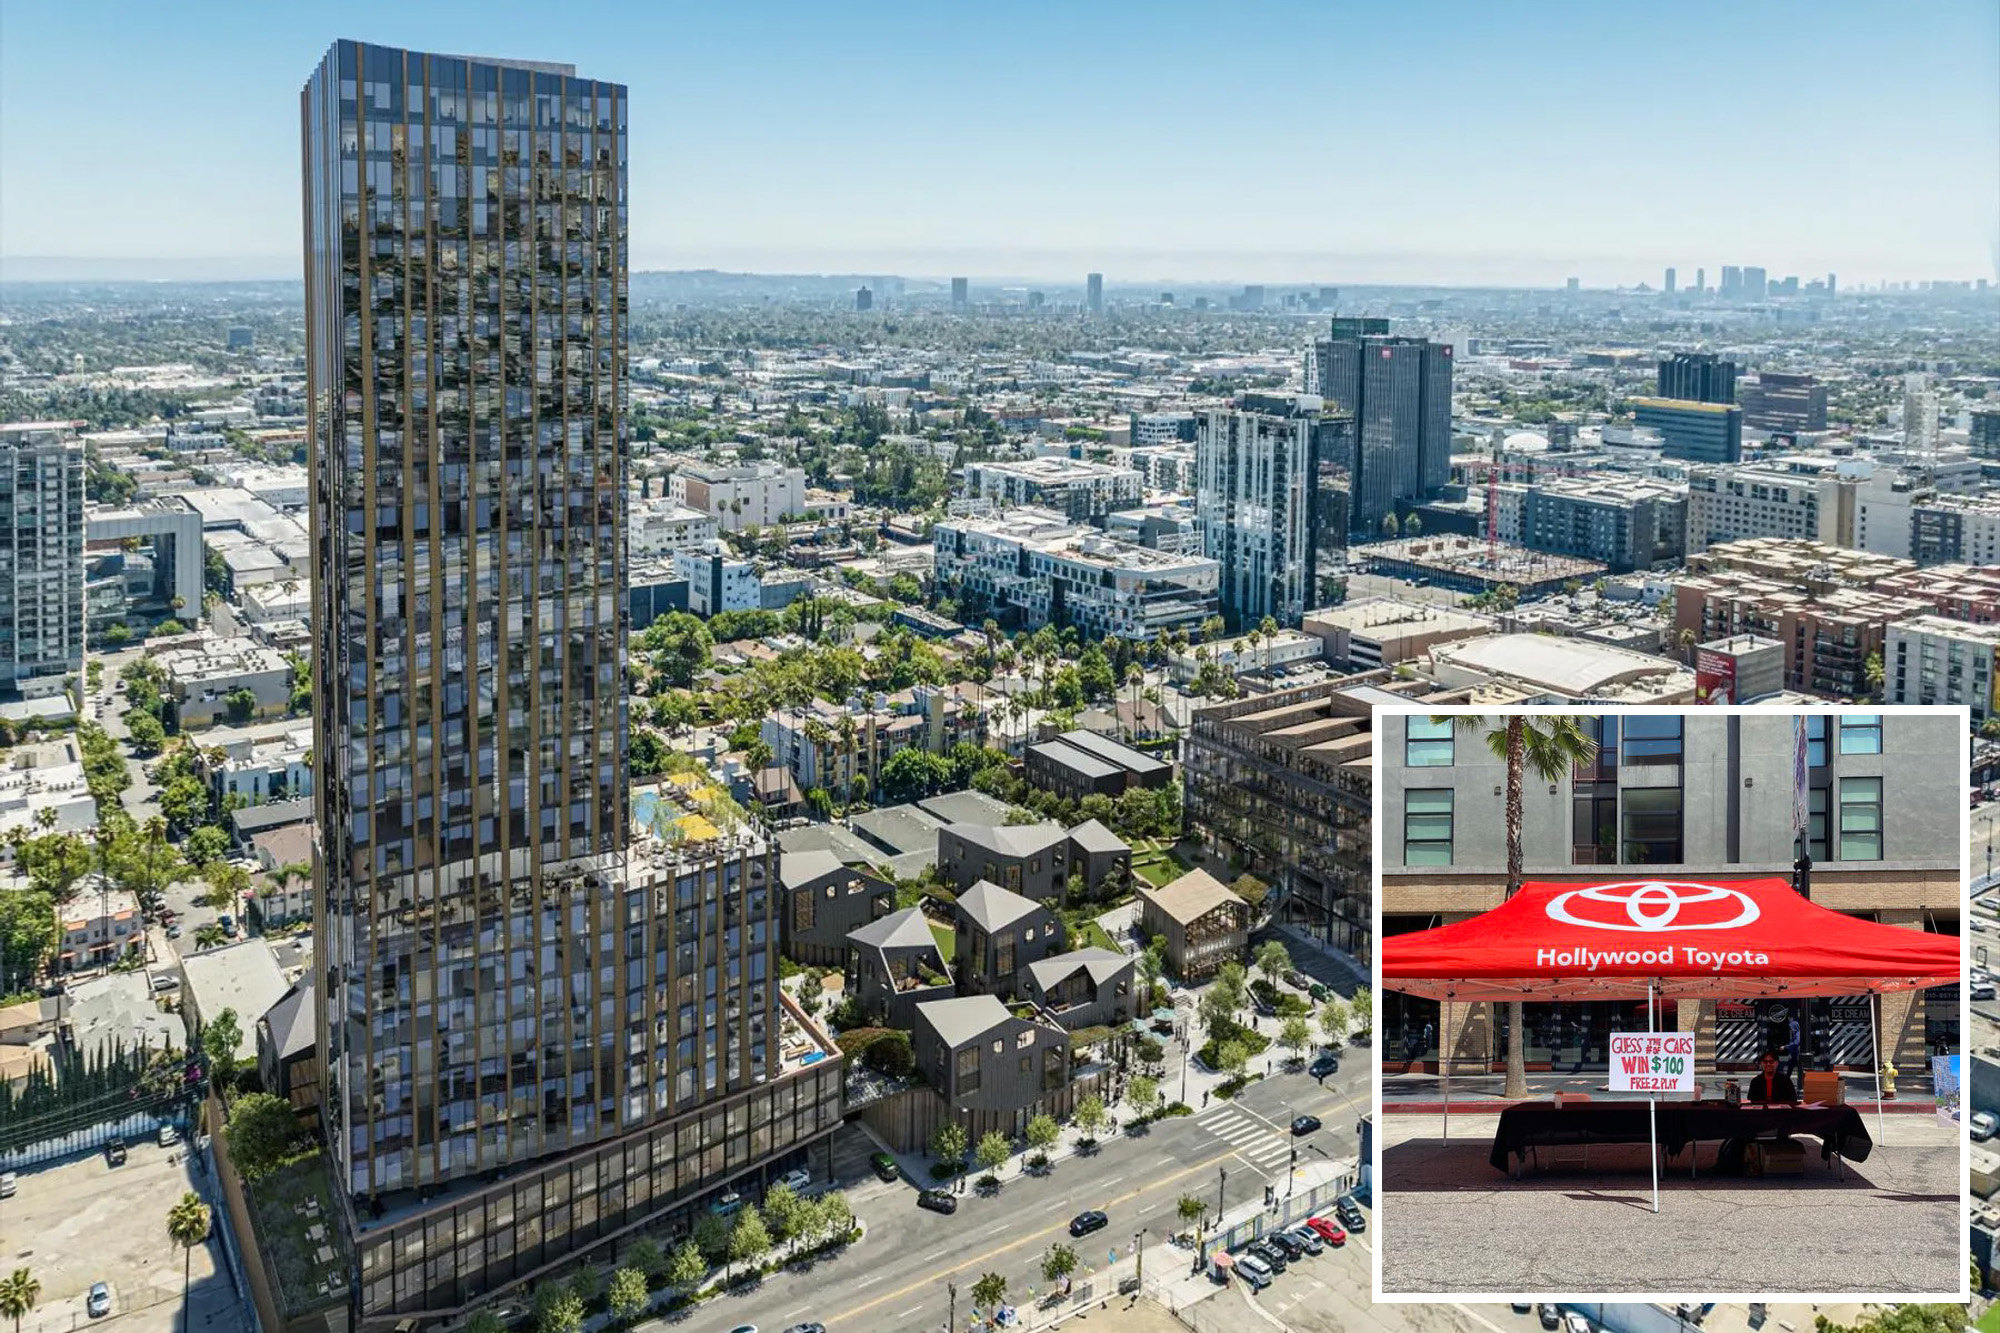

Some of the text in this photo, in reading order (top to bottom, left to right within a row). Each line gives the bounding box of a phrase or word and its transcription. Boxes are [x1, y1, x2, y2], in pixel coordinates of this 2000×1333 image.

[1537, 947, 1769, 971] Hollywood Toyota
[1718, 1009, 1755, 1018] ICE CREAM
[1831, 1009, 1870, 1018] ICE CREAM
[1612, 1037, 1643, 1053] GUESS
[1664, 1038, 1693, 1054] CARS
[1621, 1056, 1684, 1075] WIN $100
[1630, 1077, 1678, 1089] FREE 2 PLAY
